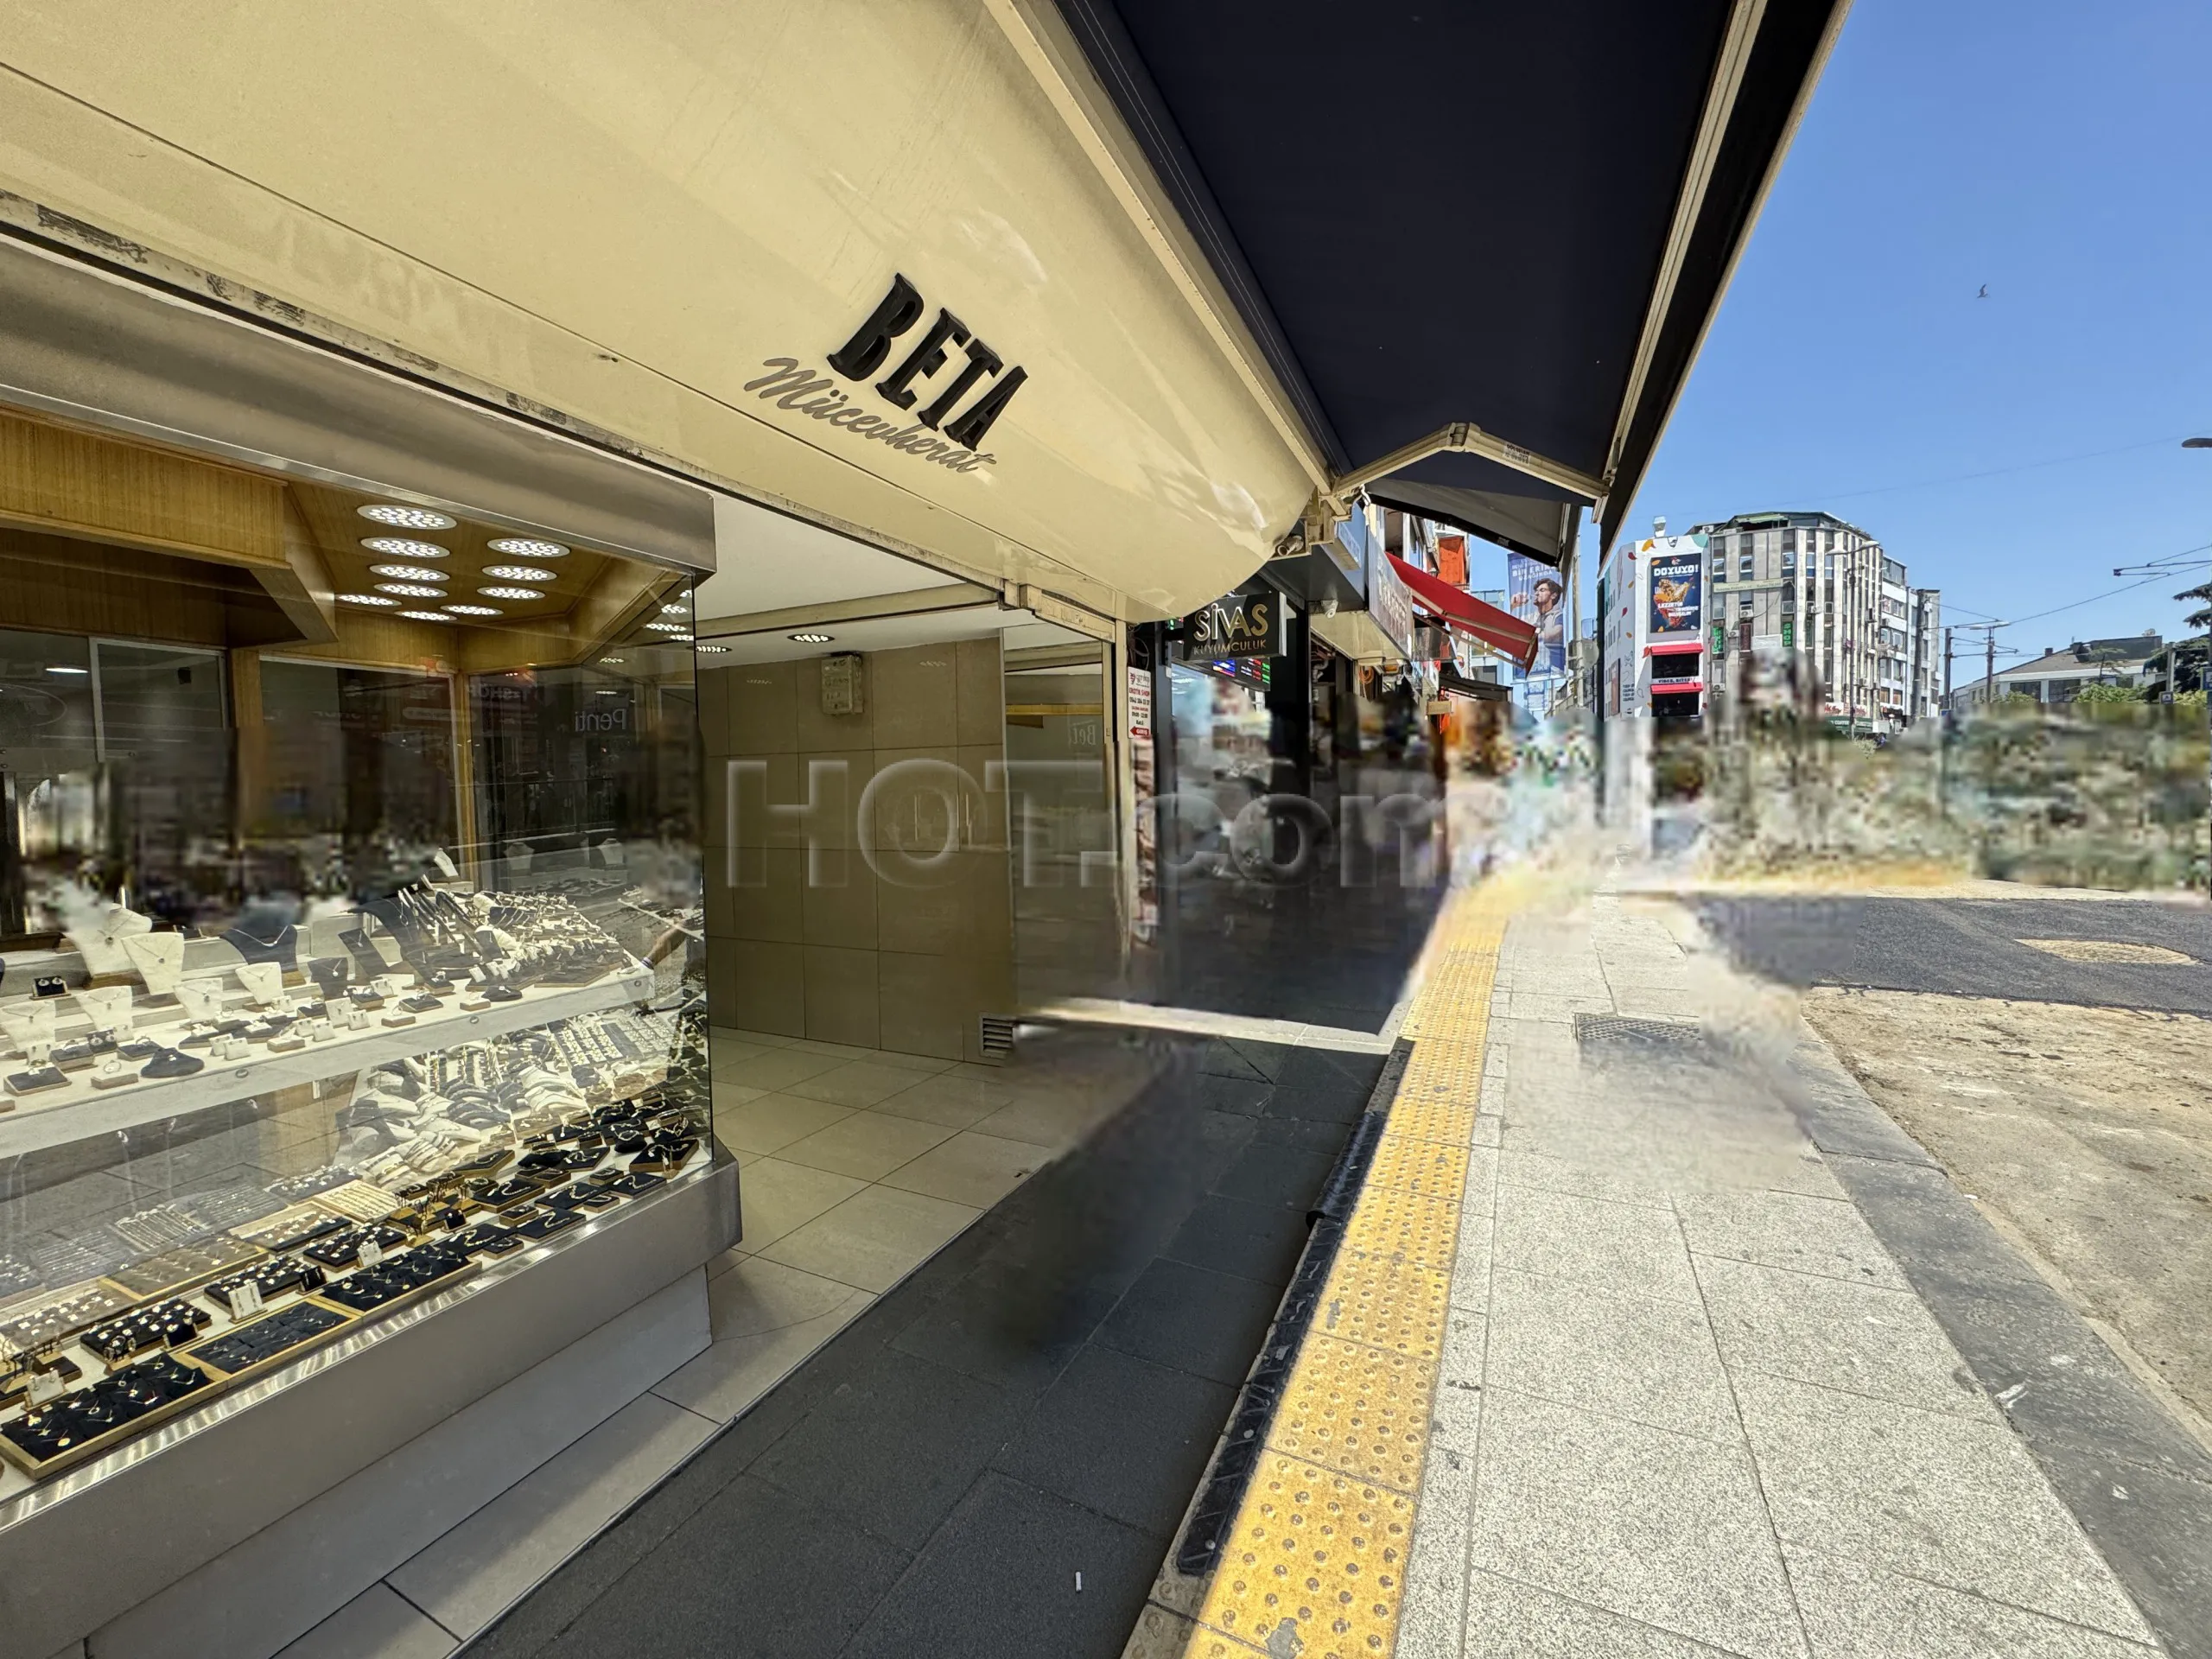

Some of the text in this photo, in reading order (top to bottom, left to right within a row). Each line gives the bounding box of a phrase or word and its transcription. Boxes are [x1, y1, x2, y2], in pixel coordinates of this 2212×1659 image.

[744, 357, 997, 474] Mücevherat
[827, 272, 1029, 452] BETA
[1193, 639, 1267, 656] KUYUMCULUK
